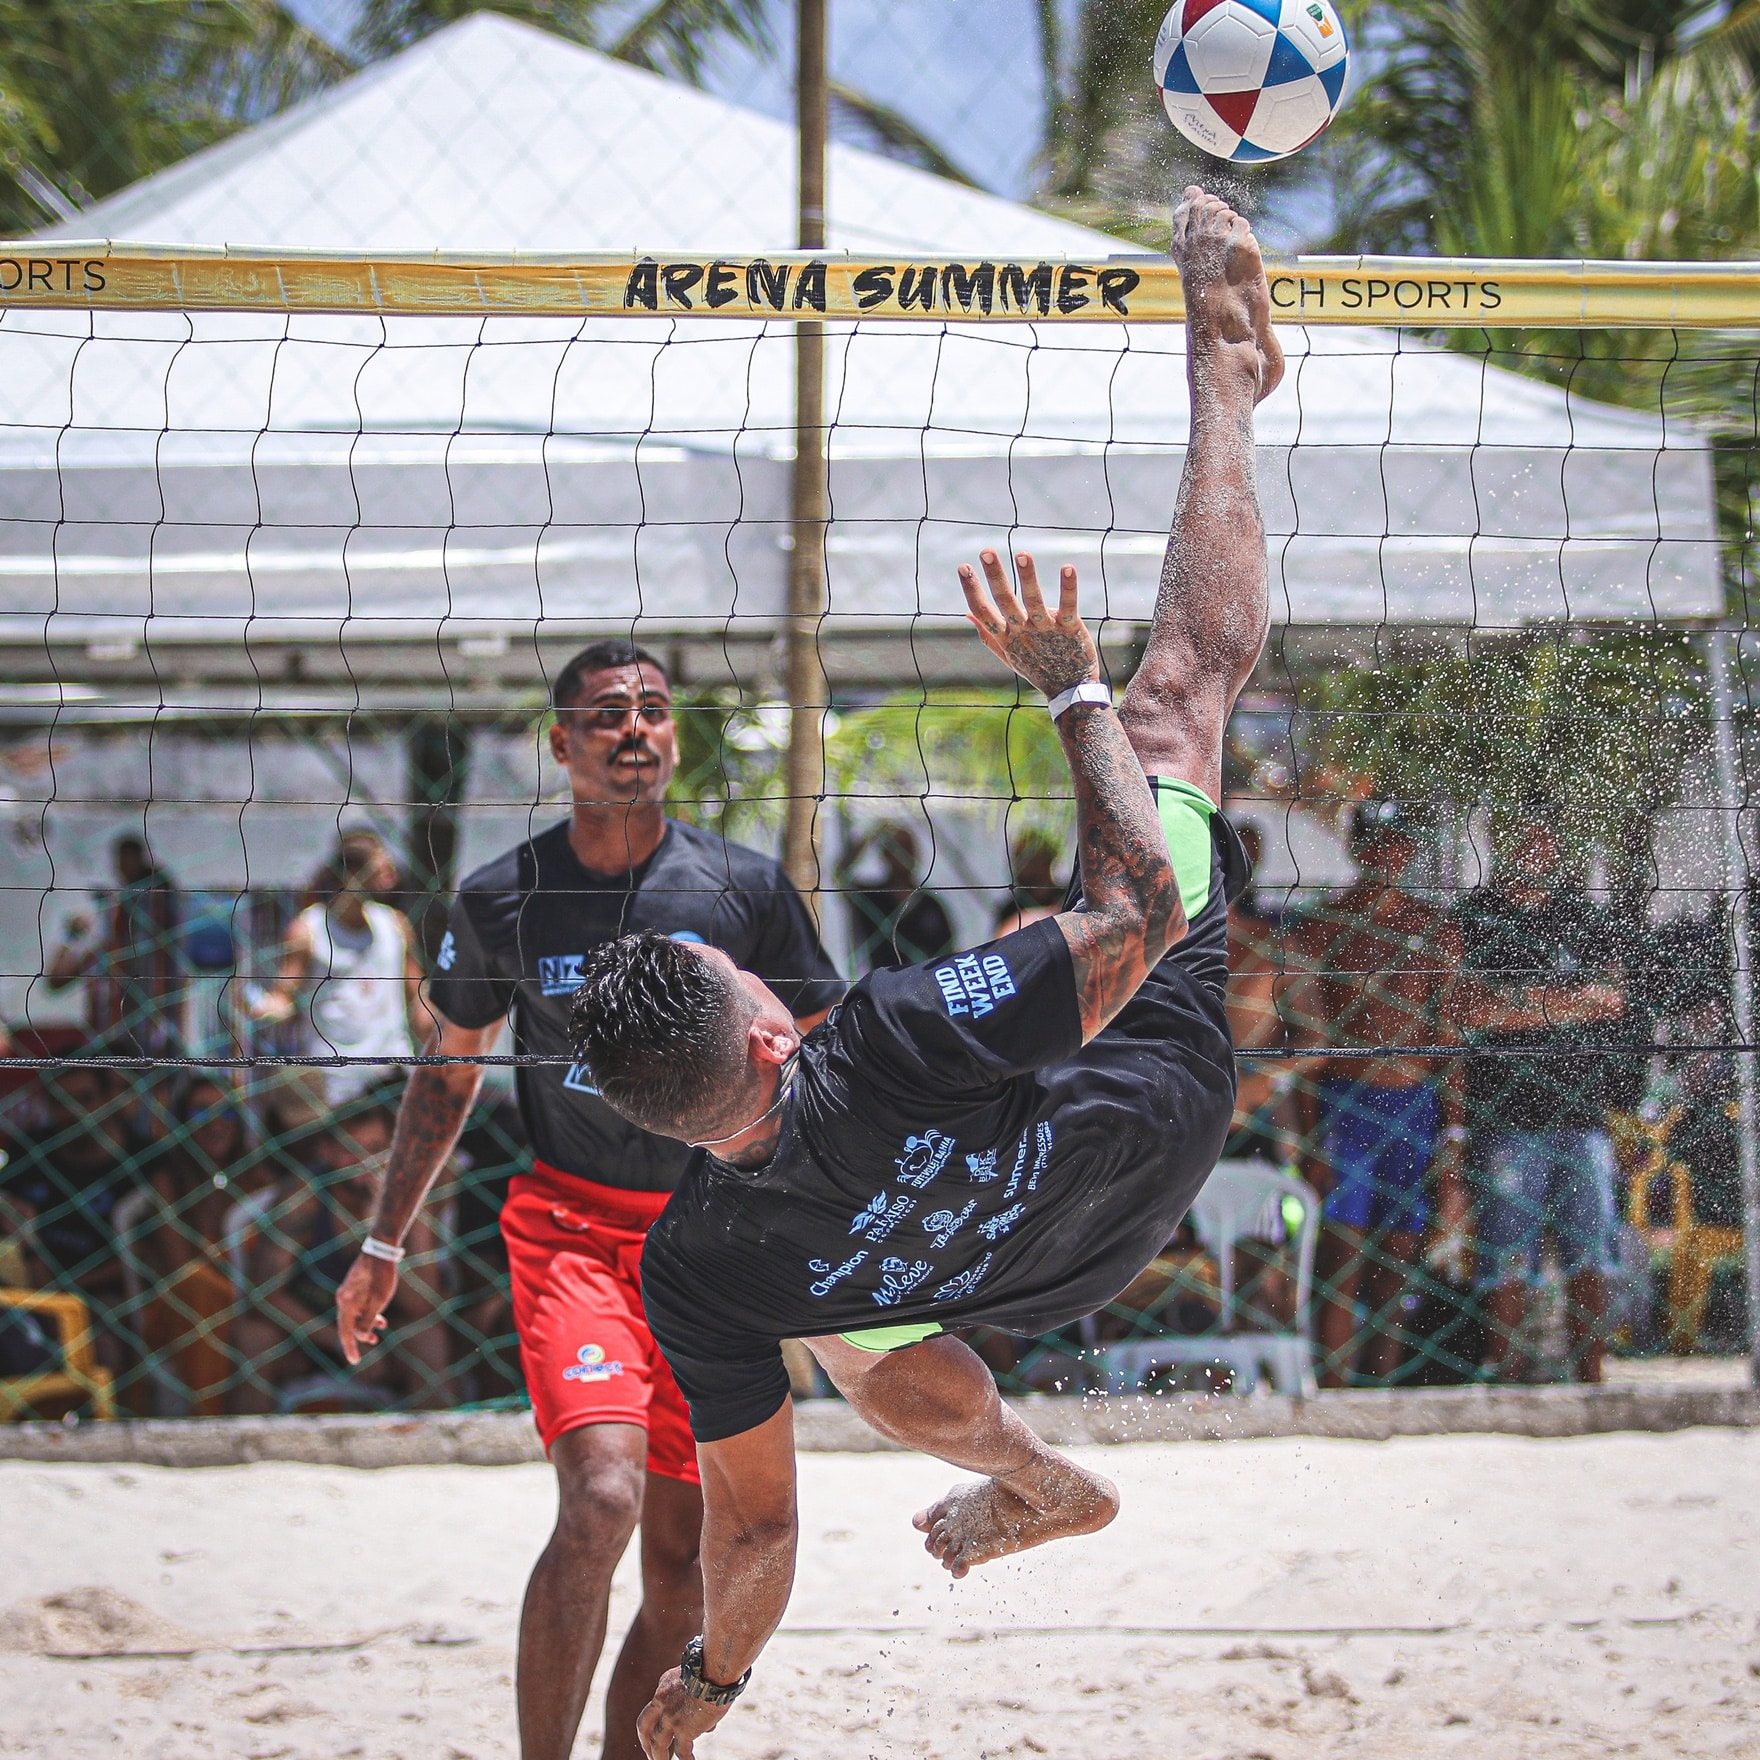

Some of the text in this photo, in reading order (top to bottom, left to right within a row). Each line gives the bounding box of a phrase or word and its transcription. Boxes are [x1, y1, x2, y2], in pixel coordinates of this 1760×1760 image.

[623, 257, 1140, 316] ARENA SUMMER
[1341, 279, 1502, 309] SPORTS
[935, 967, 969, 1016] FIND
[954, 953, 994, 1019] WEEK
[982, 955, 1016, 1000] END
[934, 1137, 952, 1160] BAHIA
[809, 1249, 869, 1297] Champion
